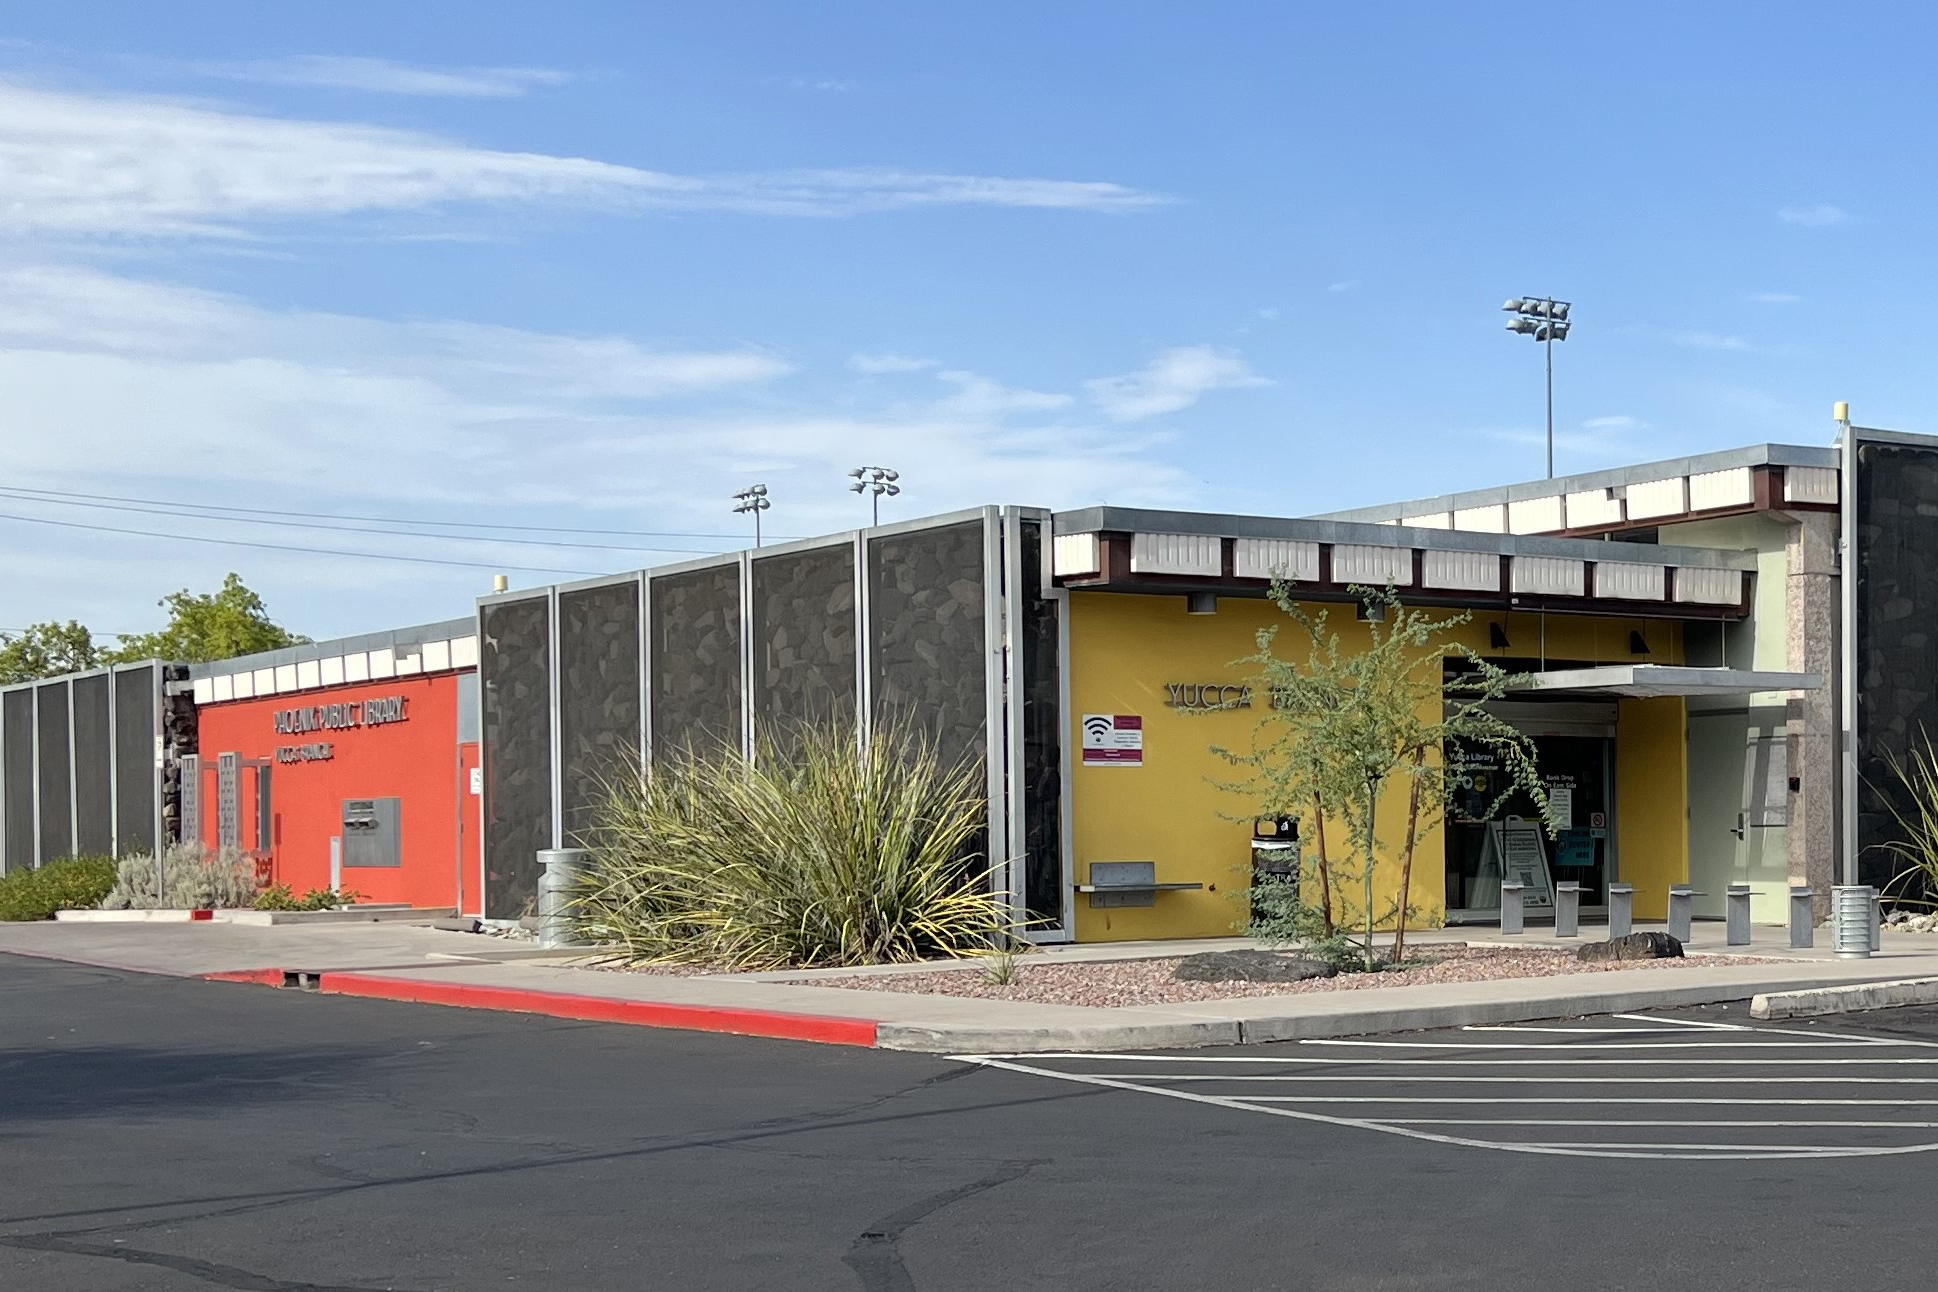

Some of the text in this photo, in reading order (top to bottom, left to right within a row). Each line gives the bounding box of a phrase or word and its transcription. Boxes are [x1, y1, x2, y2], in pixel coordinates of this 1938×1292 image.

[1166, 683, 1253, 709] YUCCA
[319, 701, 359, 728] PUBLIC
[360, 695, 409, 725] LIBRARY
[1449, 752, 1494, 763] Yua Library
[1561, 774, 1574, 782] Drop
